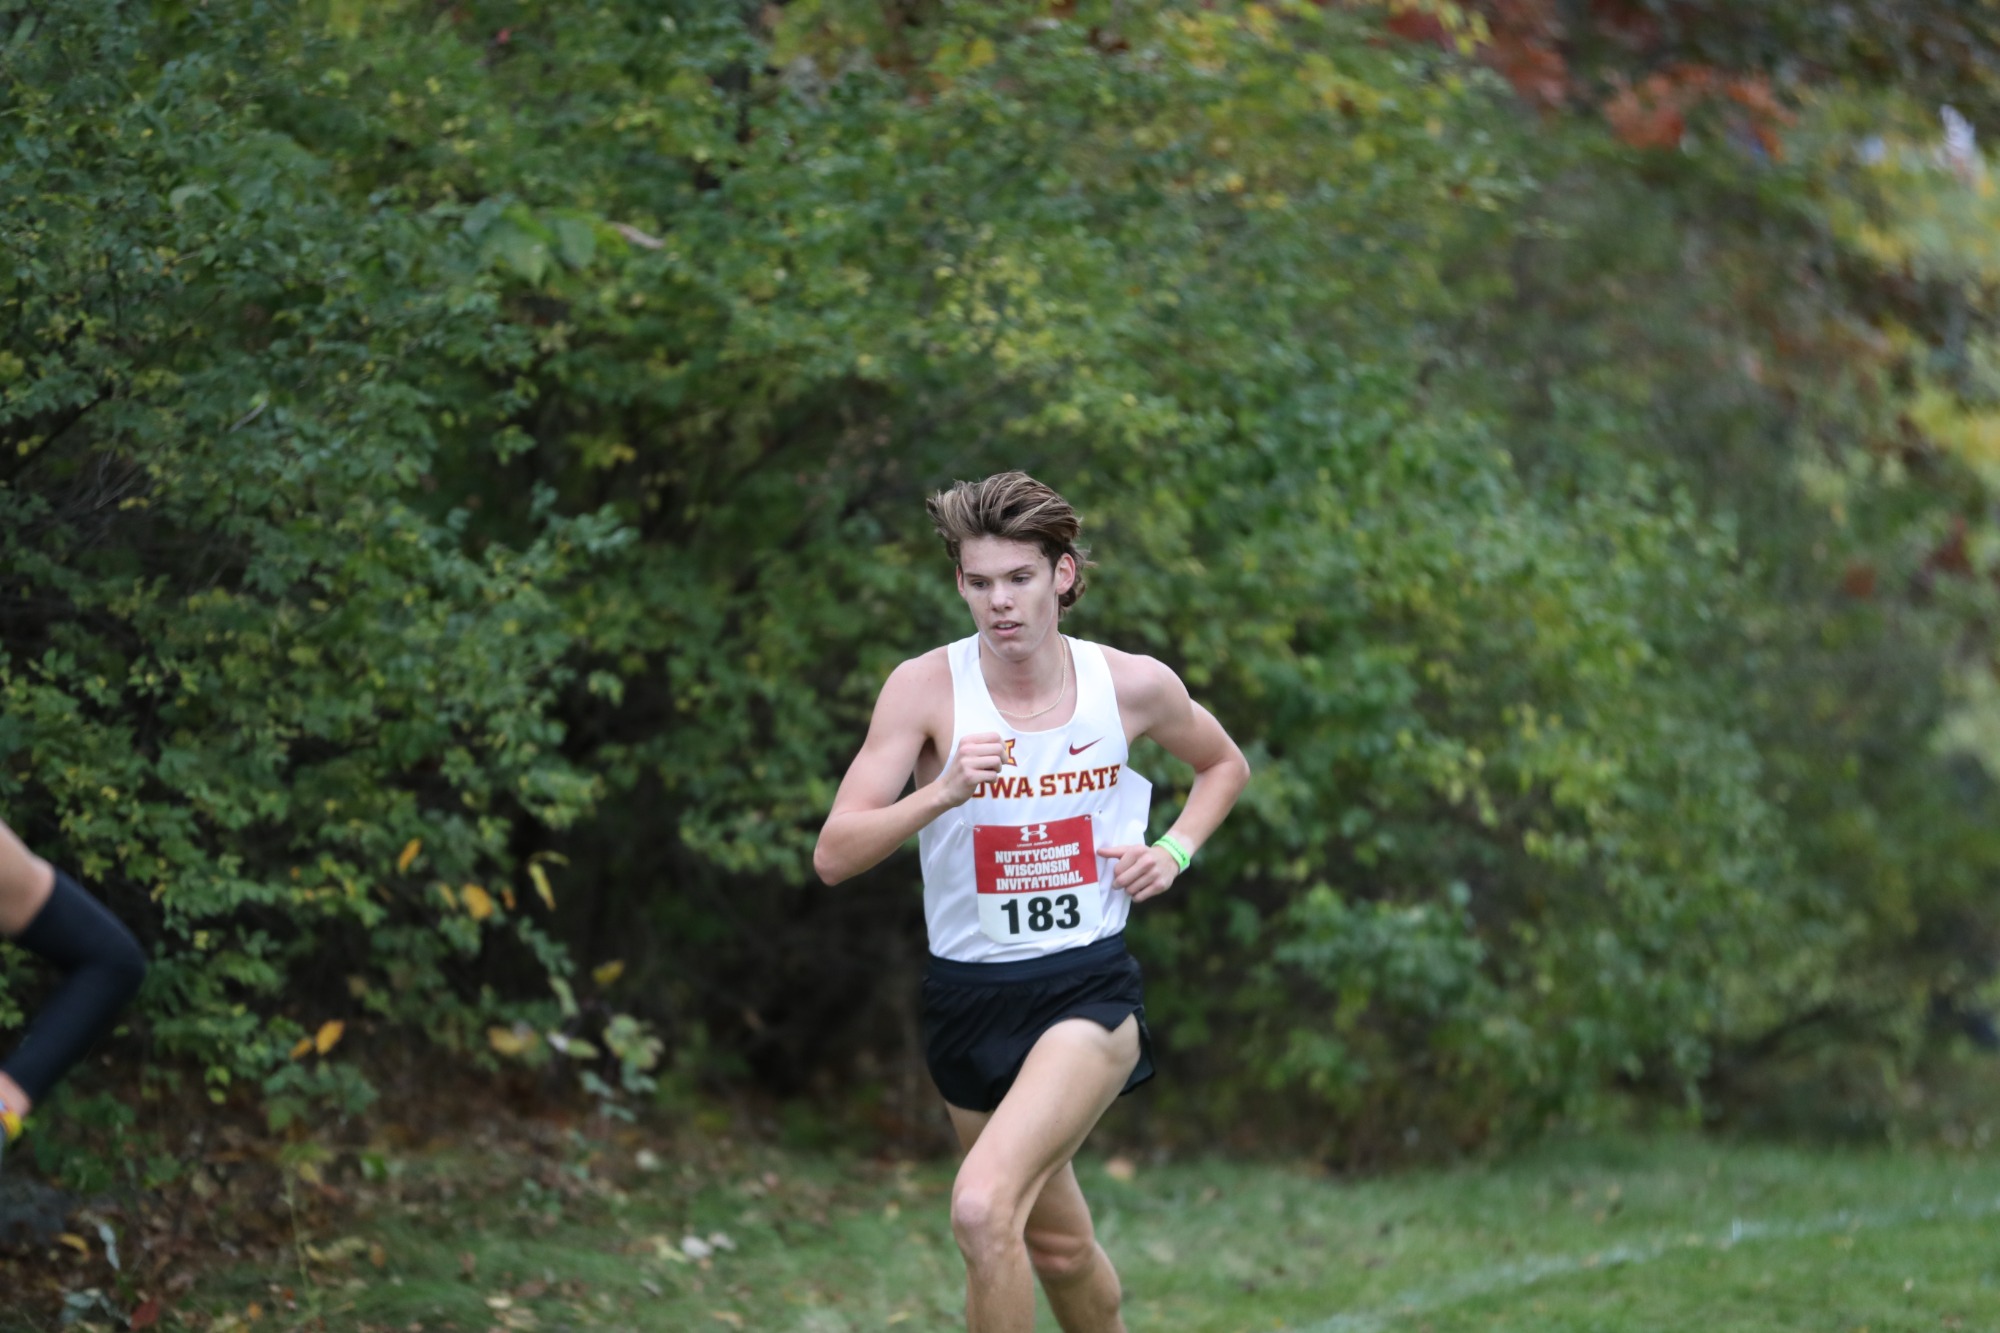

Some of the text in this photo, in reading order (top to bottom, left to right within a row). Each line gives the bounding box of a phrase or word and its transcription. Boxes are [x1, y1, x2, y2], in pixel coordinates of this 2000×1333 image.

[972, 764, 1121, 799] WA STATE
[995, 842, 1080, 864] NUTTYCOMBE
[1004, 858, 1070, 877] WISCONSIN
[996, 870, 1083, 891] INVITATIONAL
[1000, 893, 1081, 935] 183
